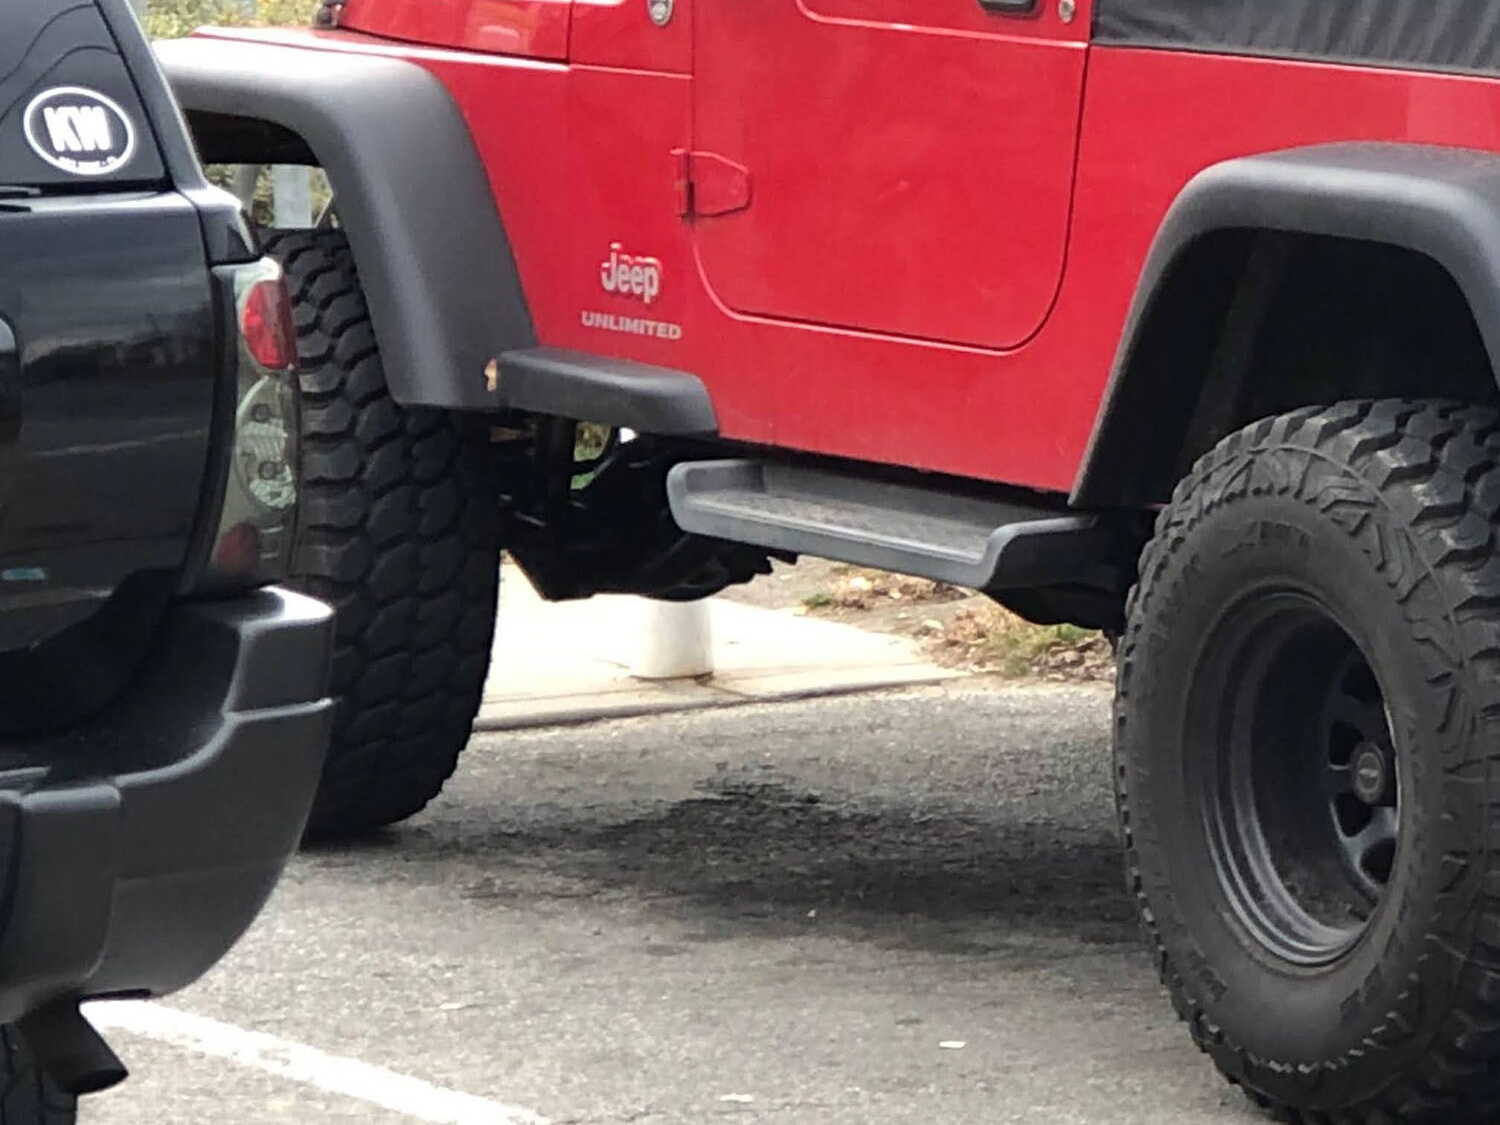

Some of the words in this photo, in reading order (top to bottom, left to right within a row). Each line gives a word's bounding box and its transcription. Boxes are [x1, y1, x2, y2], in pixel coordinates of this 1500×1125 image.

[43, 106, 112, 152] KW
[600, 242, 662, 304] Jeep
[581, 310, 682, 340] UNLIMITED
